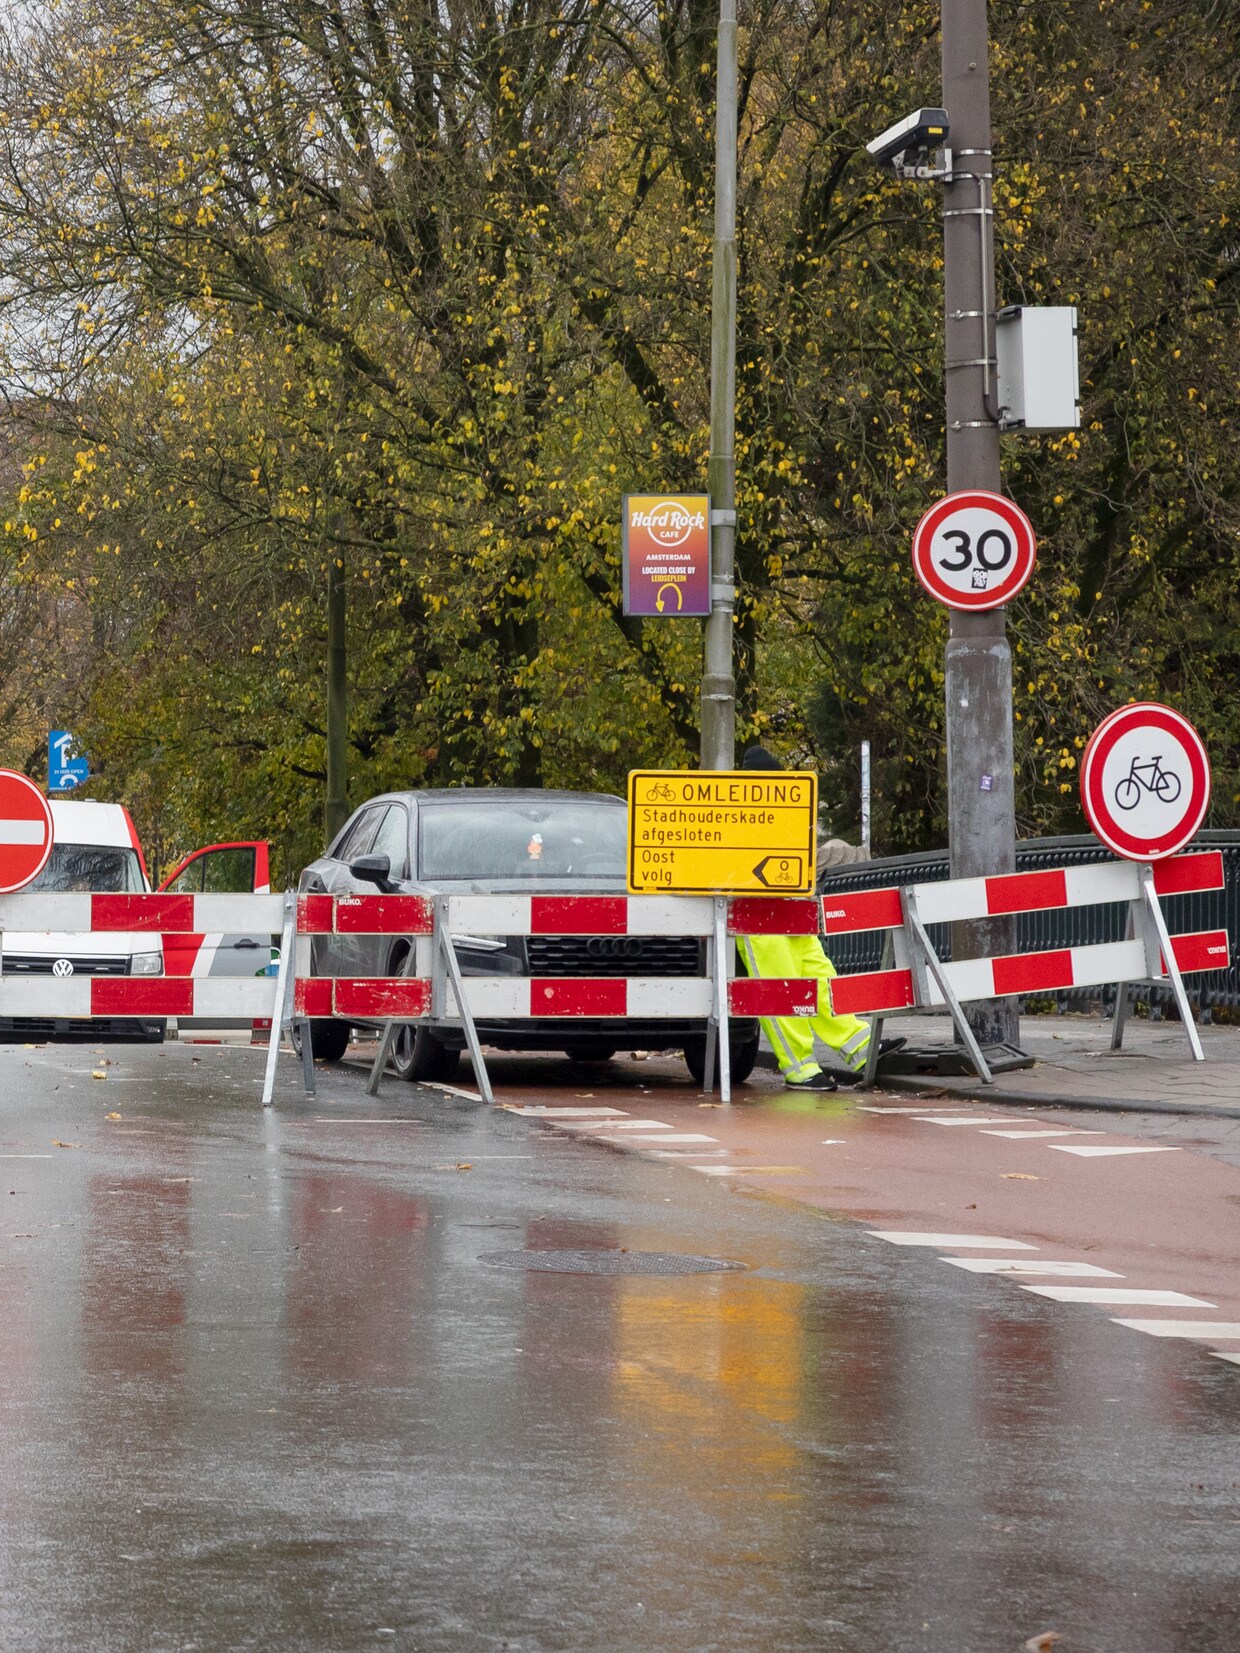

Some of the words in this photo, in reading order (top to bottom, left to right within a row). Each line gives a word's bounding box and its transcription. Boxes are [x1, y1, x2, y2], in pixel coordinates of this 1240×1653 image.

[632, 511, 669, 527] Hard
[669, 511, 705, 530] Rock
[939, 529, 1012, 571] 30
[642, 566, 668, 574] LOCATED
[668, 566, 687, 574] CLOSE
[687, 566, 696, 574] BY
[682, 784, 801, 802] OMLEIDING
[643, 809, 775, 824] Stadhouderskade
[642, 827, 722, 845] afgesloten
[642, 850, 675, 863] Oost
[641, 869, 672, 885] volg
